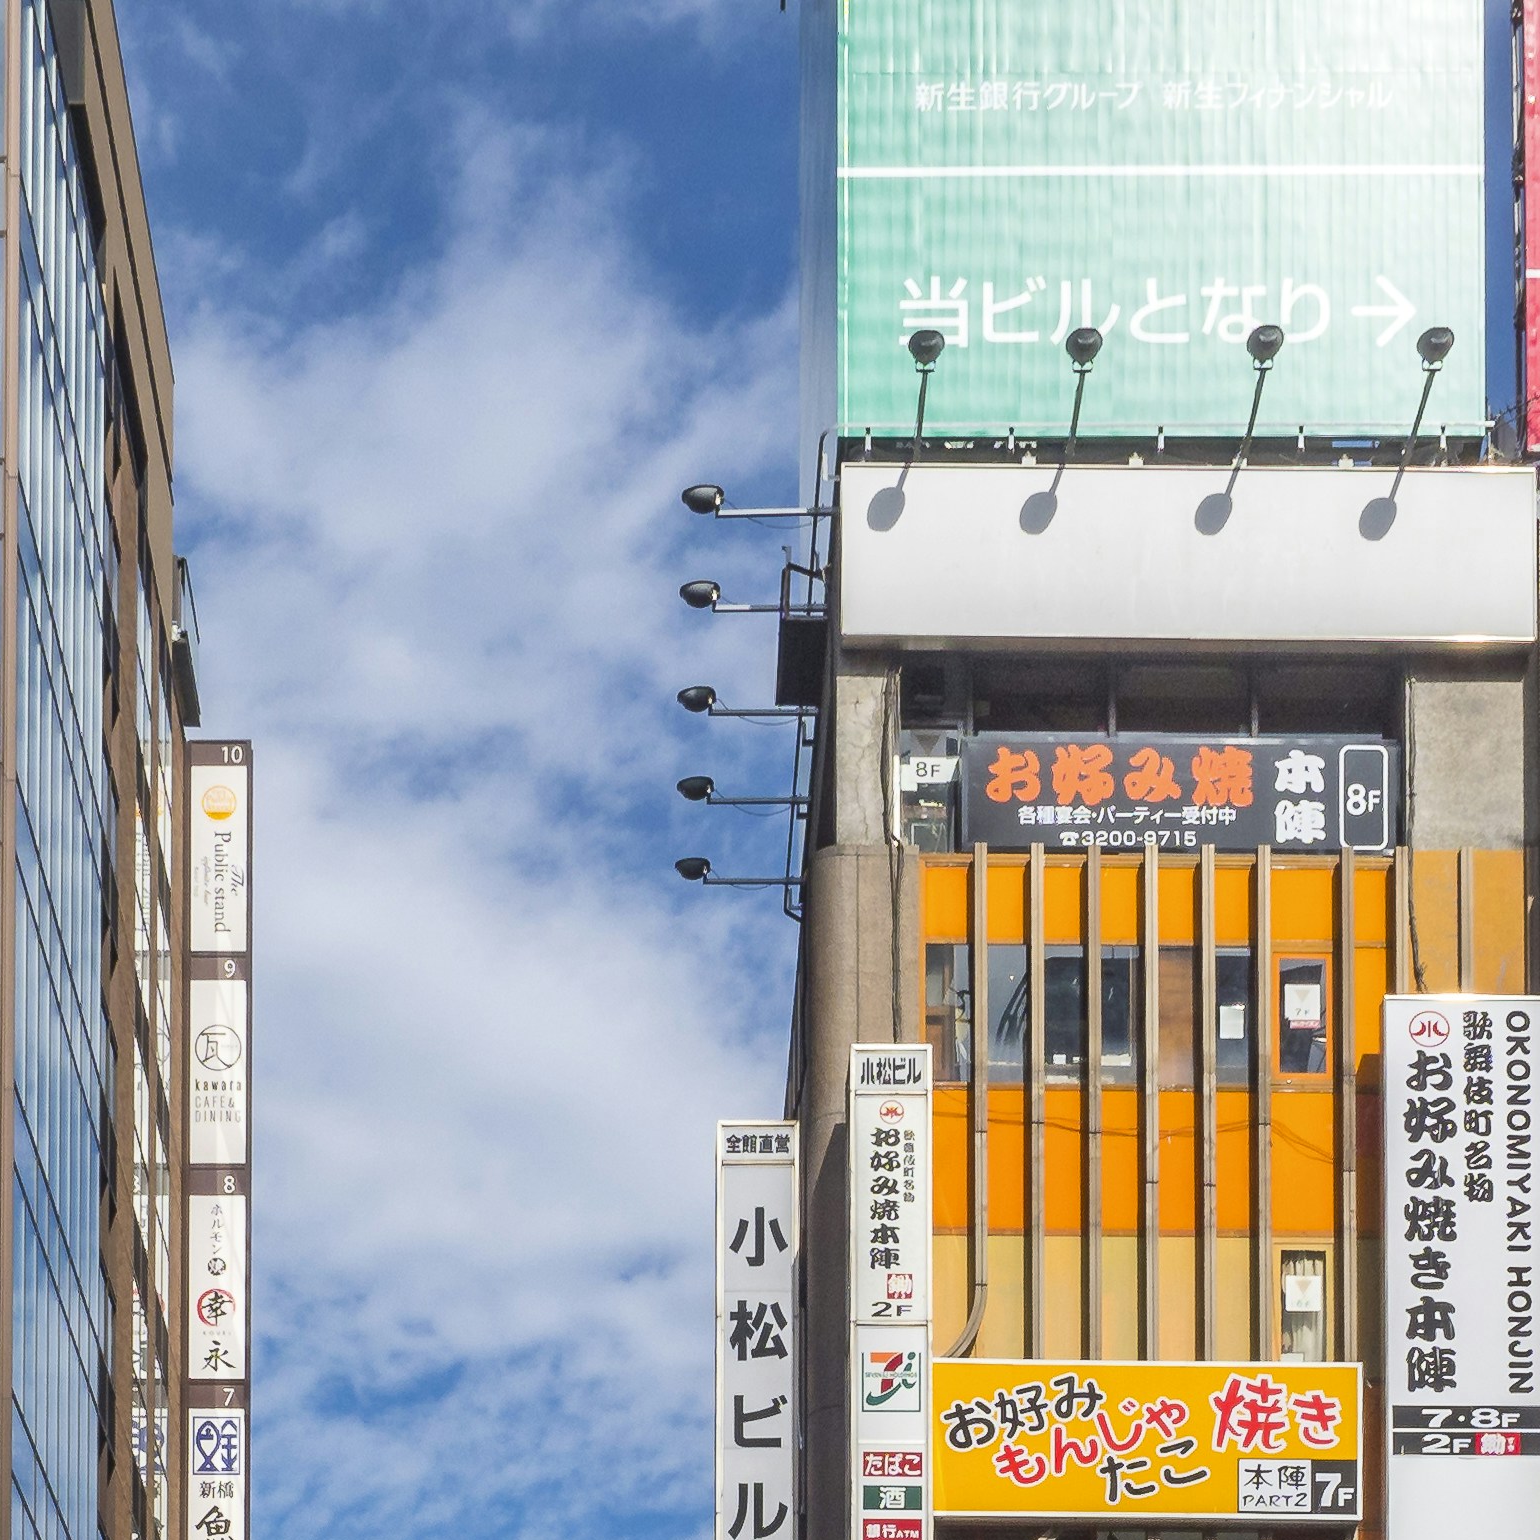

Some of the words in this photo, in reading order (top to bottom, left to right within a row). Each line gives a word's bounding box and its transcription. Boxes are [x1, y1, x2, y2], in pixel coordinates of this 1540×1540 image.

[897, 276, 1332, 350] 当ビルとなり
[220, 746, 243, 764] 10
[985, 743, 1256, 810] お好み焼
[1016, 805, 1238, 828] 各種宴会・パーティー受付中
[1079, 829, 1199, 848] 3200-9715
[213, 831, 232, 881] Public
[213, 883, 231, 934] stand
[223, 959, 236, 979] 9
[860, 1056, 922, 1086] 小松ビル
[195, 1079, 242, 1092] kawara
[726, 1134, 791, 1154] 全館直営
[1505, 1010, 1533, 1253] OKONOMIYAKI
[223, 1175, 236, 1193] 8
[869, 1127, 902, 1271] お好み焼本陣
[1403, 1050, 1458, 1394] お好み焼き本陣
[871, 1301, 914, 1318] 2F
[1506, 1266, 1534, 1396] HONJIN
[727, 1205, 790, 1540] 小松ビル
[222, 1388, 235, 1406] 7
[947, 1376, 1105, 1450] お好み
[1213, 1376, 1341, 1452] 焼き
[863, 1453, 921, 1477] たばこ
[1100, 1437, 1209, 1503] たこ
[199, 1480, 234, 1498] 新橋
[878, 1486, 906, 1509] 酒
[865, 1521, 920, 1540] 銀行ATM
